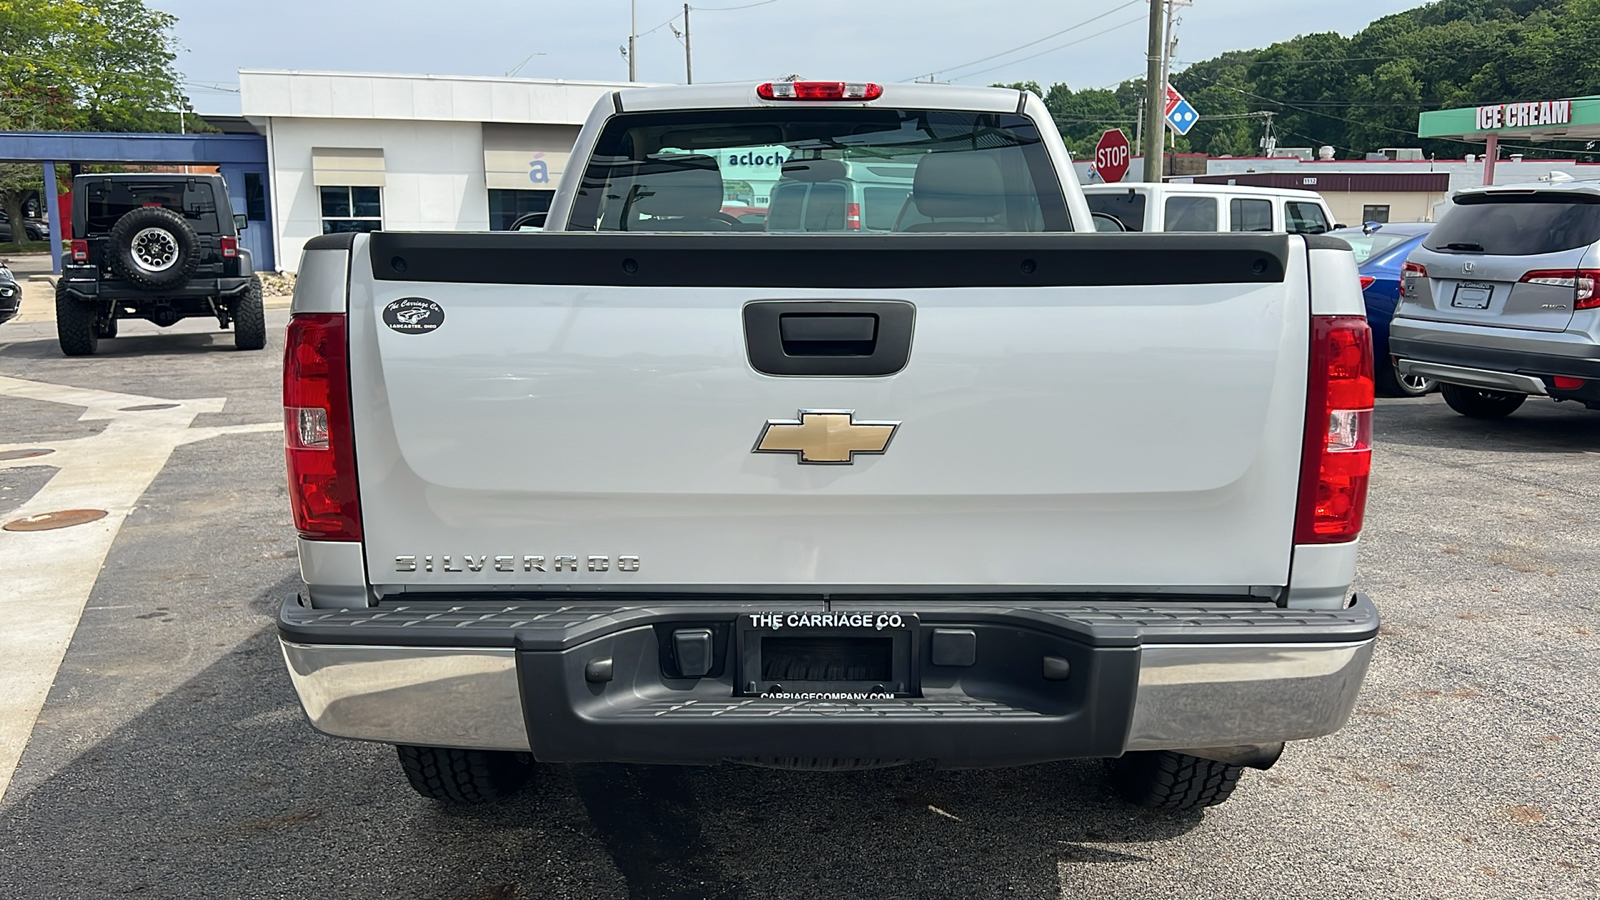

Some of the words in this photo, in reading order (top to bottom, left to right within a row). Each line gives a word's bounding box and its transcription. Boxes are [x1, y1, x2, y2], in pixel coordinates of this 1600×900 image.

[1476, 105, 1503, 130] ICE
[1506, 100, 1571, 127] CREAM
[1098, 145, 1128, 169] STOP
[401, 299, 429, 308] Carriage
[395, 555, 640, 572] SILVERADO
[750, 614, 784, 628] THE
[787, 614, 873, 628] CARRIAGE
[876, 614, 905, 628] CO.
[760, 692, 894, 700] CARRIAGECOMPANYCOM
